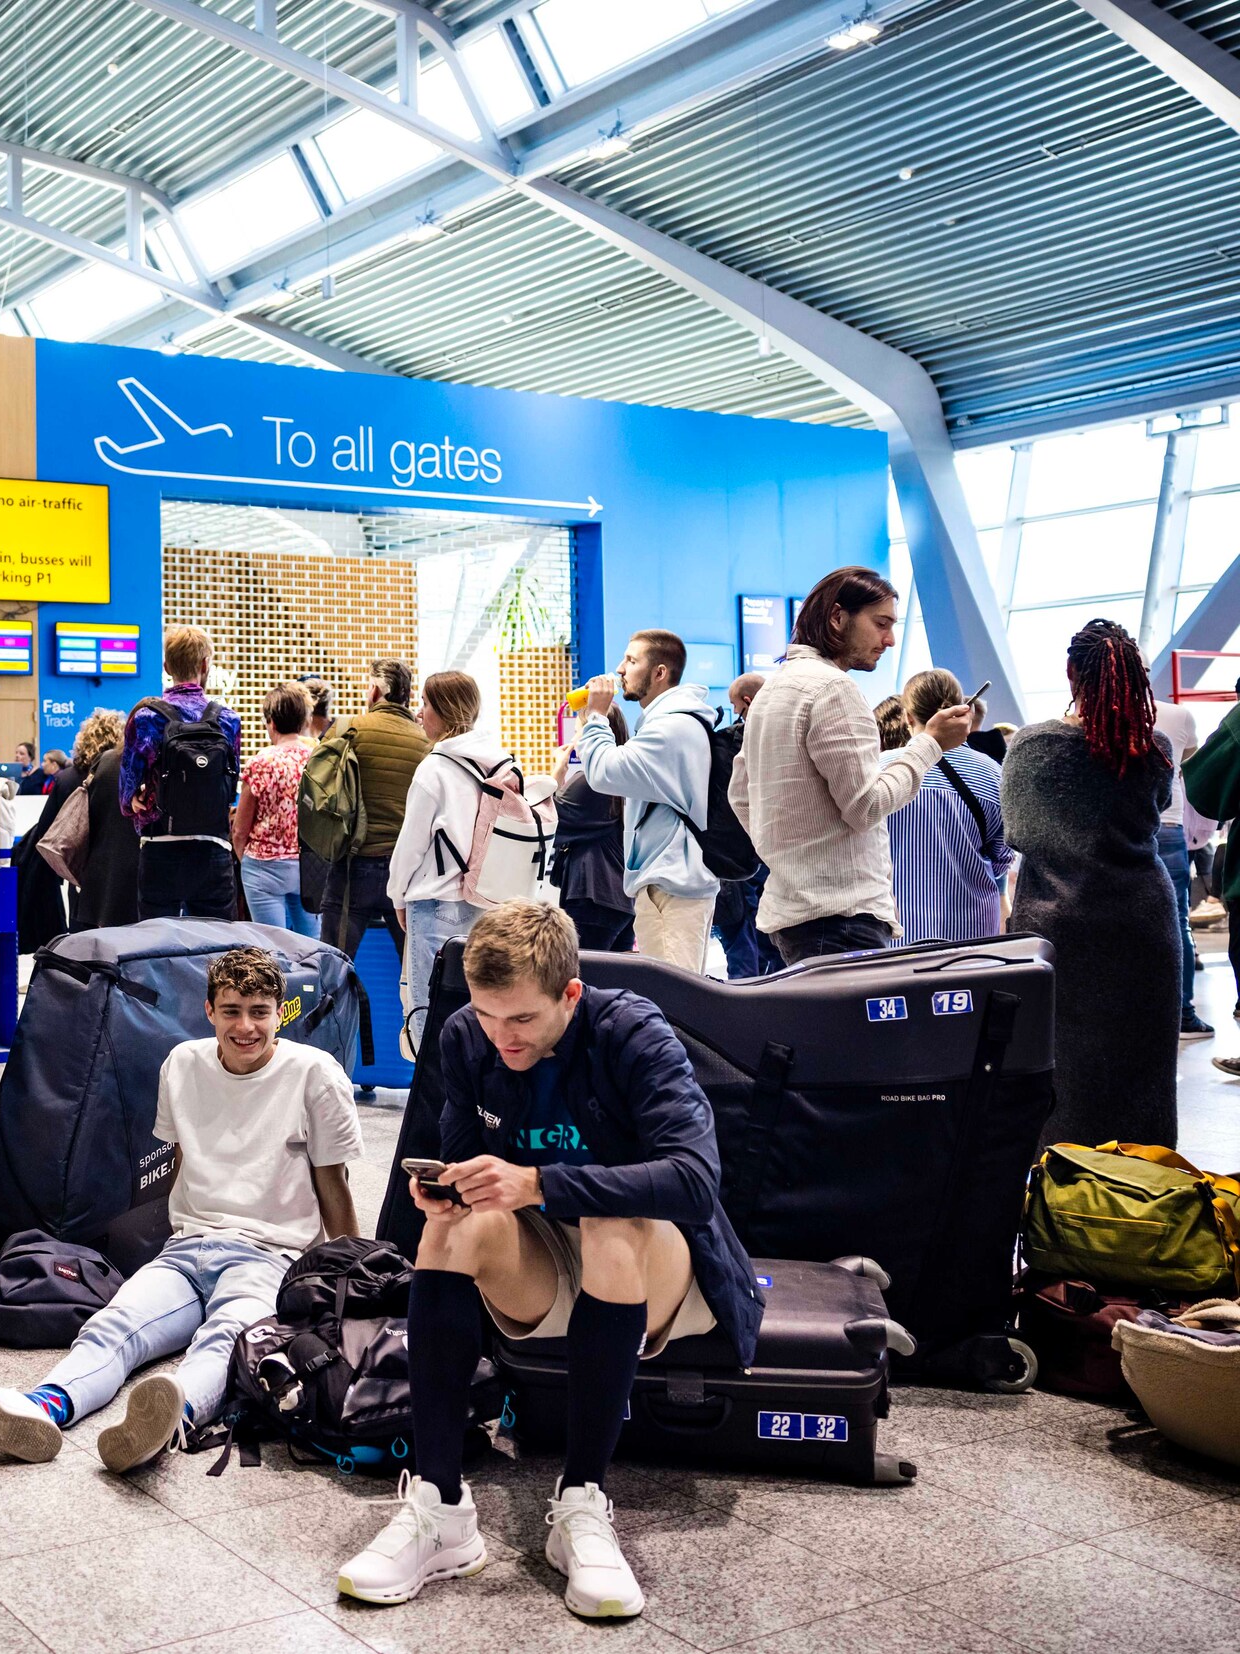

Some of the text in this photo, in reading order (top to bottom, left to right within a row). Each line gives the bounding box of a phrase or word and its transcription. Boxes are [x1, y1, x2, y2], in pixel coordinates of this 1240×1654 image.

[262, 416, 502, 487] To all gates
[19, 495, 83, 511] air-traffic
[20, 552, 65, 567] busses
[69, 555, 92, 567] will
[37, 573, 52, 584] P1
[43, 699, 75, 714] Fast
[44, 714, 75, 728] Track
[879, 999, 896, 1019] 34
[937, 993, 969, 1012] 19
[771, 1415, 791, 1437] 22
[816, 1417, 836, 1439] 32
